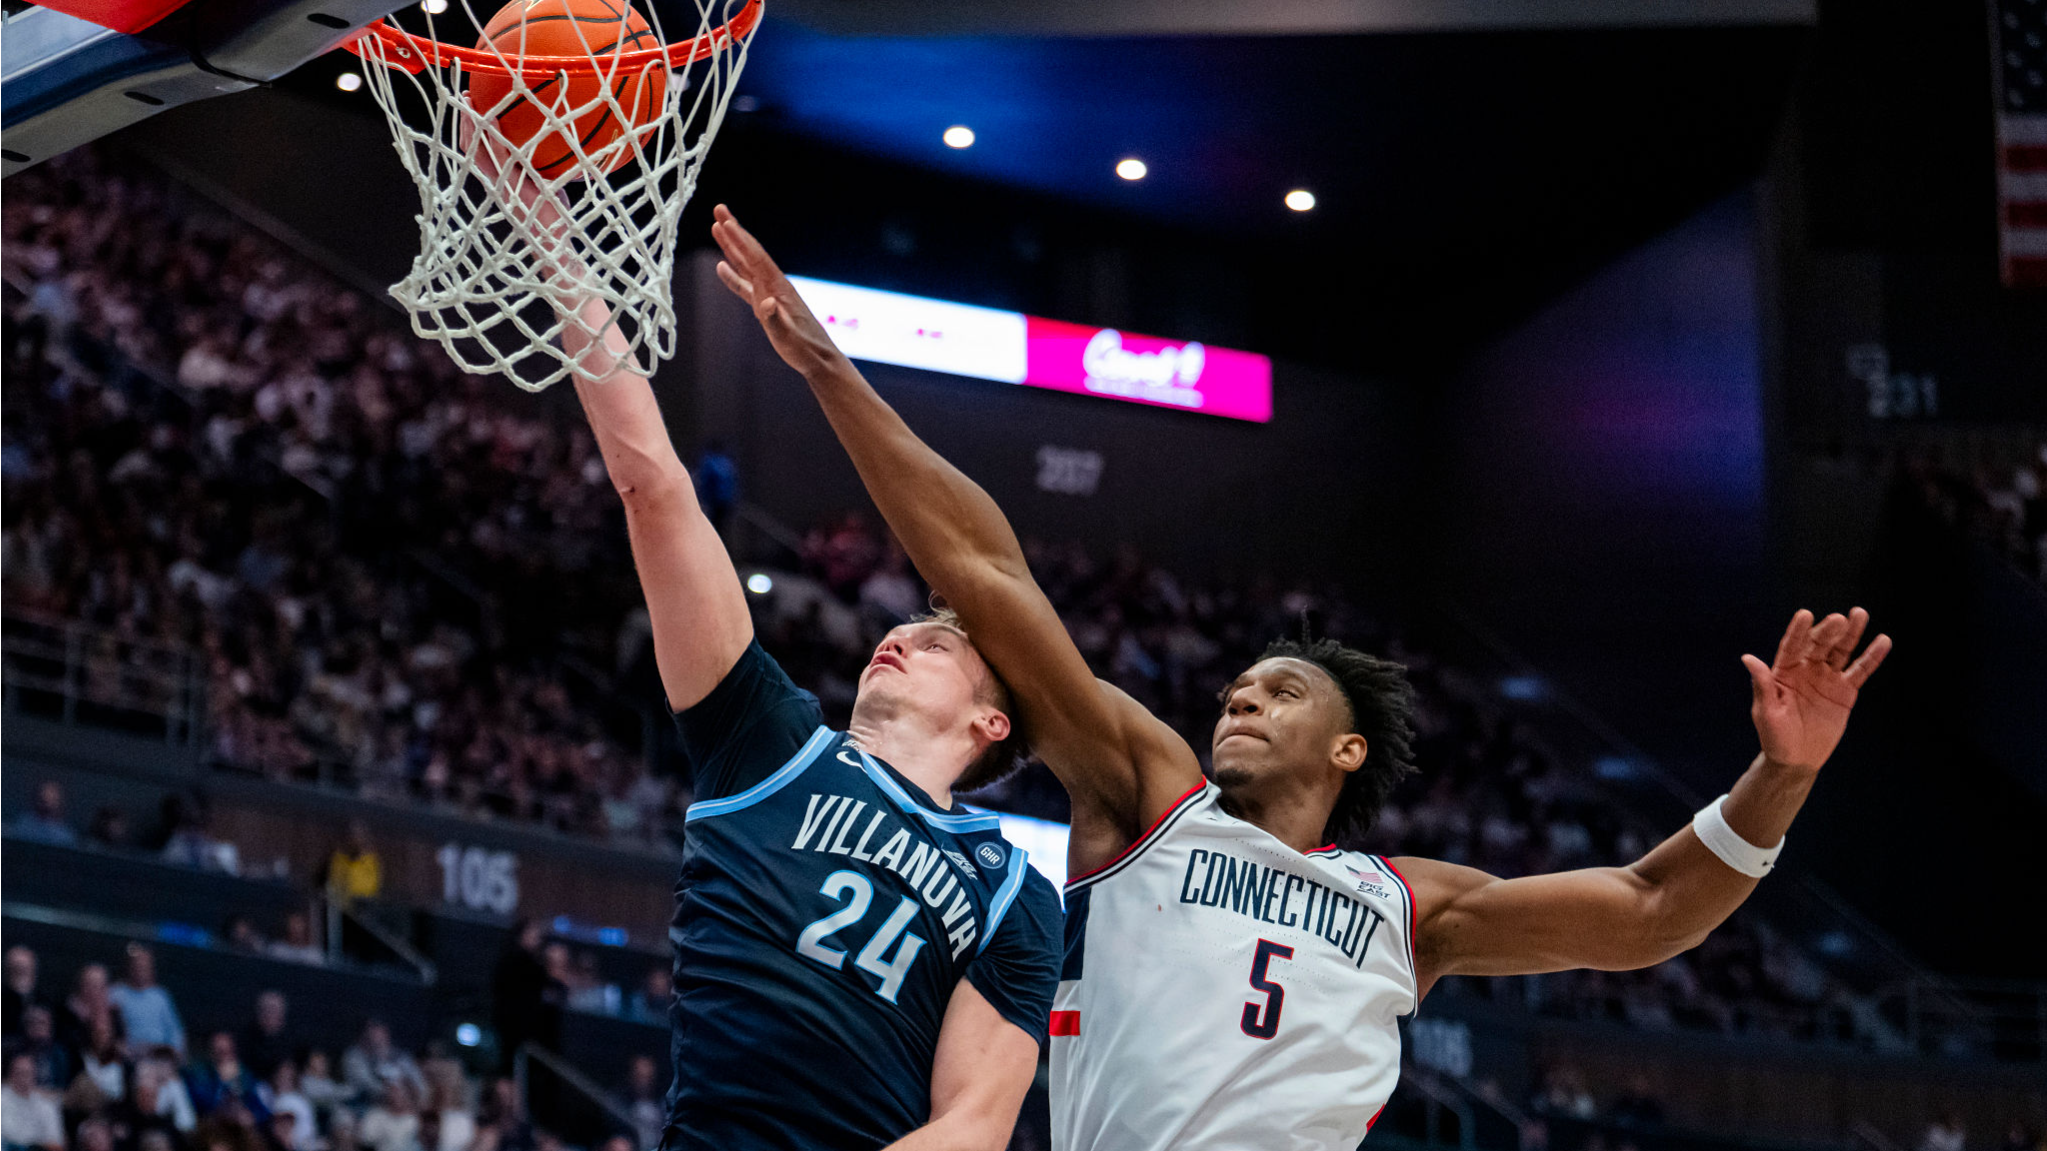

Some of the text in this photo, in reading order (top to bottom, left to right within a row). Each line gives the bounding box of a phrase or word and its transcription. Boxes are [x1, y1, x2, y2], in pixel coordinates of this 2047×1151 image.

[437, 846, 517, 912] 105
[791, 794, 976, 963] VILLANOVA
[980, 846, 1001, 865] GHR
[1358, 885, 1391, 898] EAST
[1359, 881, 1384, 891] BIG
[796, 870, 927, 1005] 24
[1180, 848, 1385, 969] CONNECTICUT
[1240, 938, 1294, 1040] 5
